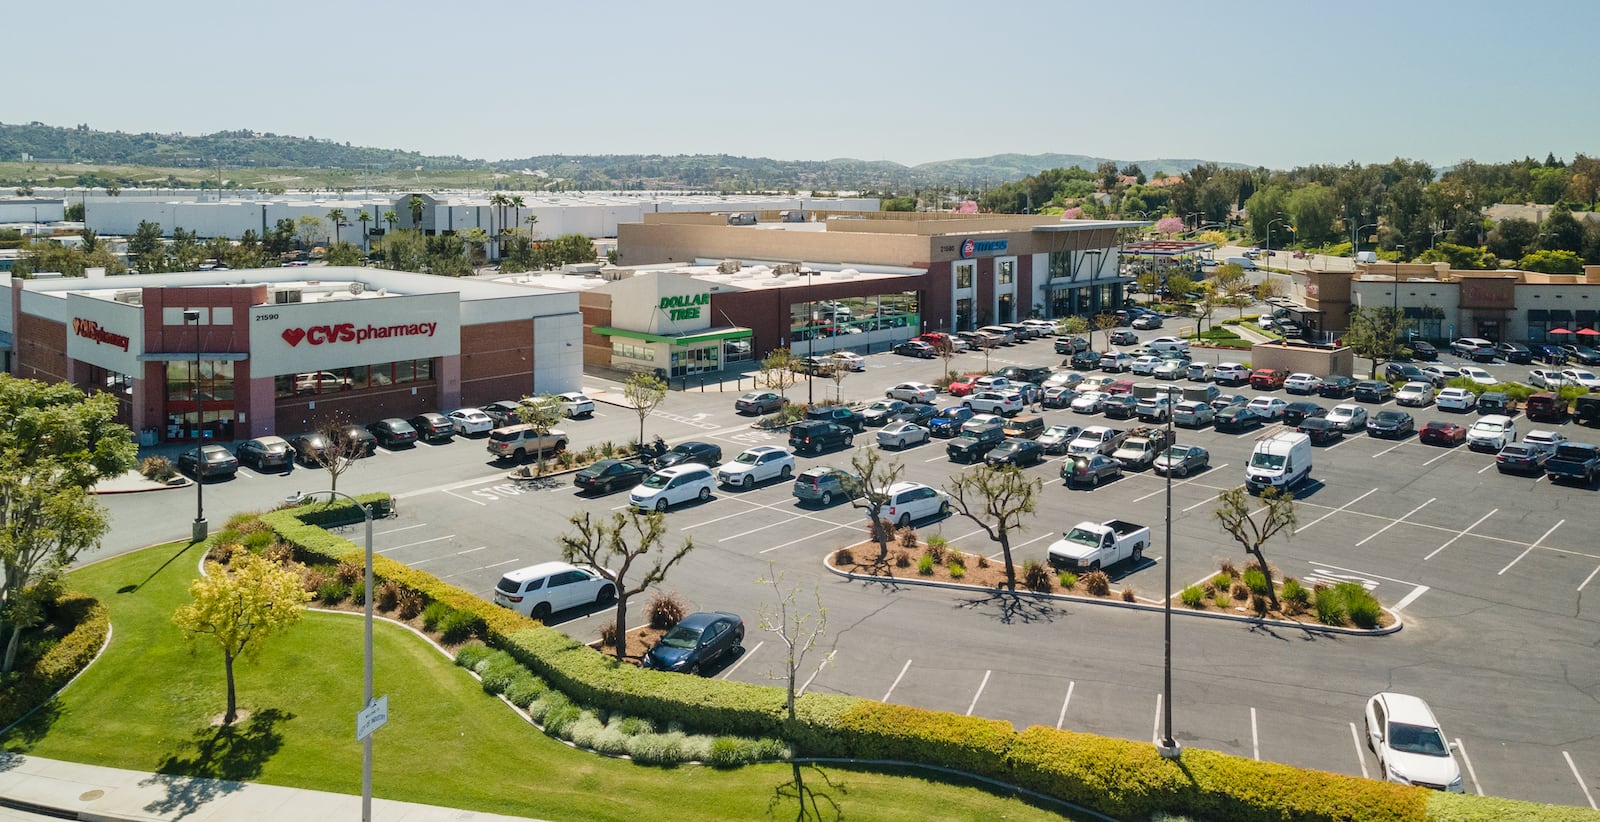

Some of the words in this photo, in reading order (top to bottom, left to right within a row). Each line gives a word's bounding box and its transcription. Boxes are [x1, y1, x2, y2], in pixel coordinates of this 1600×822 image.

[660, 293, 709, 309] DOLLAR
[255, 313, 279, 322] 21590
[670, 307, 701, 321] TREE
